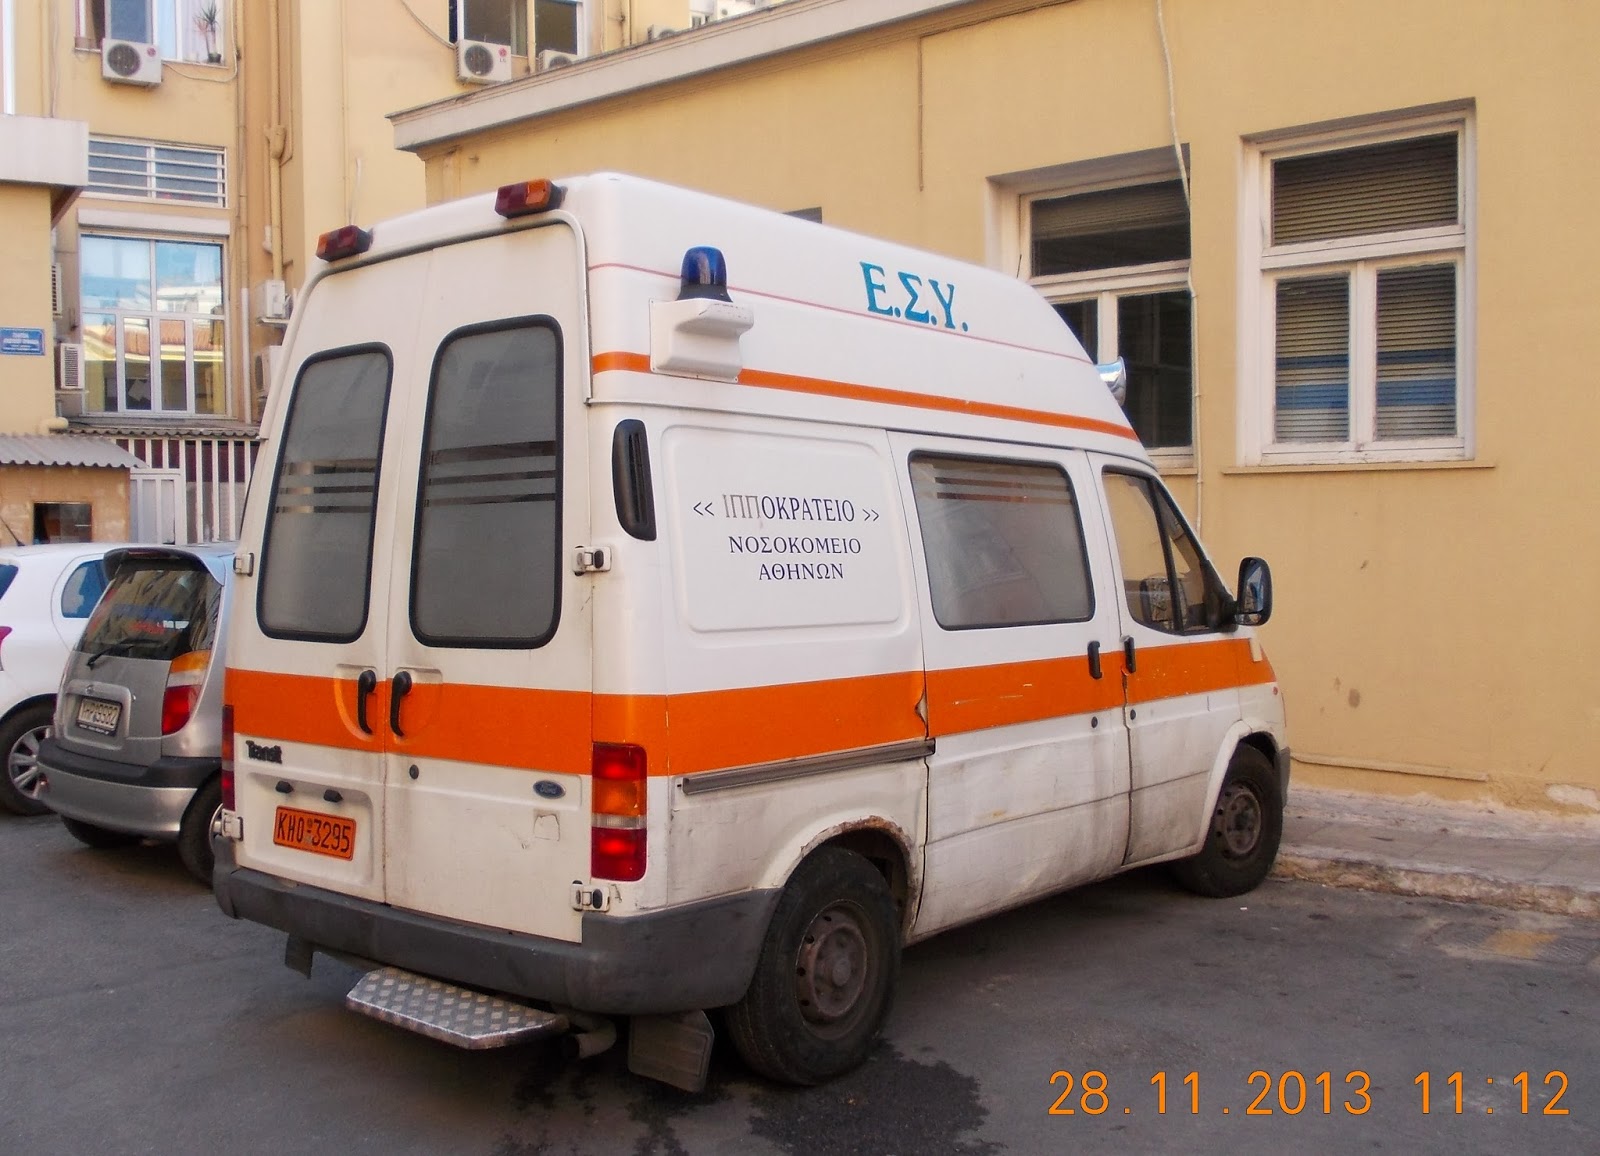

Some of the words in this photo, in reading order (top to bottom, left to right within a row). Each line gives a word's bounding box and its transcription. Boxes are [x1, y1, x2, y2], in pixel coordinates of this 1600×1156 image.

[859, 260, 968, 332] Ε.Σ.Υ.
[722, 494, 855, 522] ΙΠΠΟΚΡΑΤΕΙΟ
[728, 536, 862, 554] ΝΟΣΟΚΟΜΕΙΟ
[758, 562, 845, 581] ΑΘΗΝΩΝ
